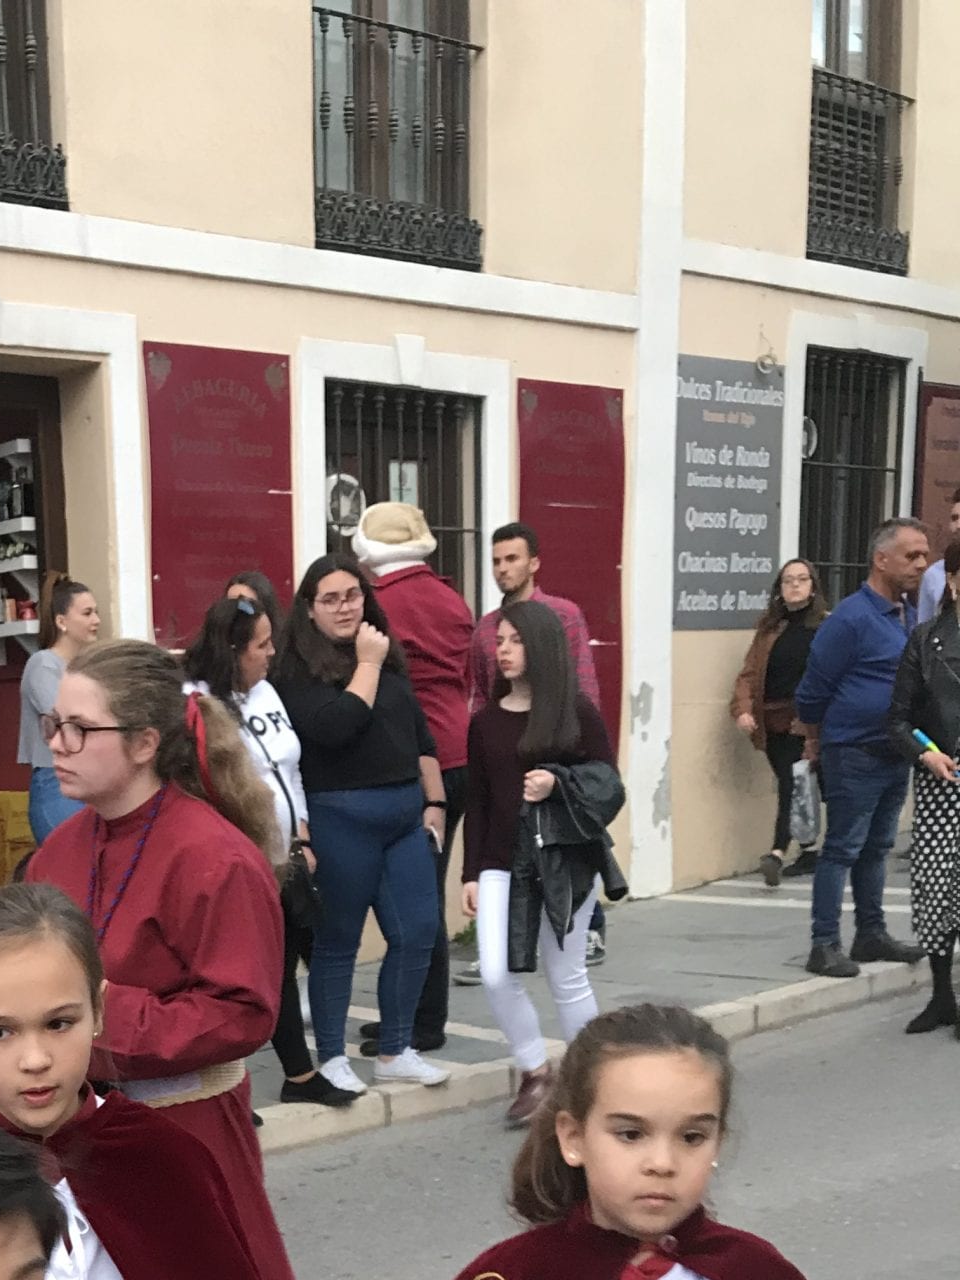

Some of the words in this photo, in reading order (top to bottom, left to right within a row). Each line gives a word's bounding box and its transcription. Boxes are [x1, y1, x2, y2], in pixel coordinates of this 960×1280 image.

[685, 441, 717, 465] Vinos
[718, 444, 734, 466] de
[735, 445, 771, 468] Ronda
[685, 506, 728, 532] Quesos
[678, 551, 728, 573] Chacinas
[678, 588, 719, 611] Aceites
[721, 590, 736, 611] de
